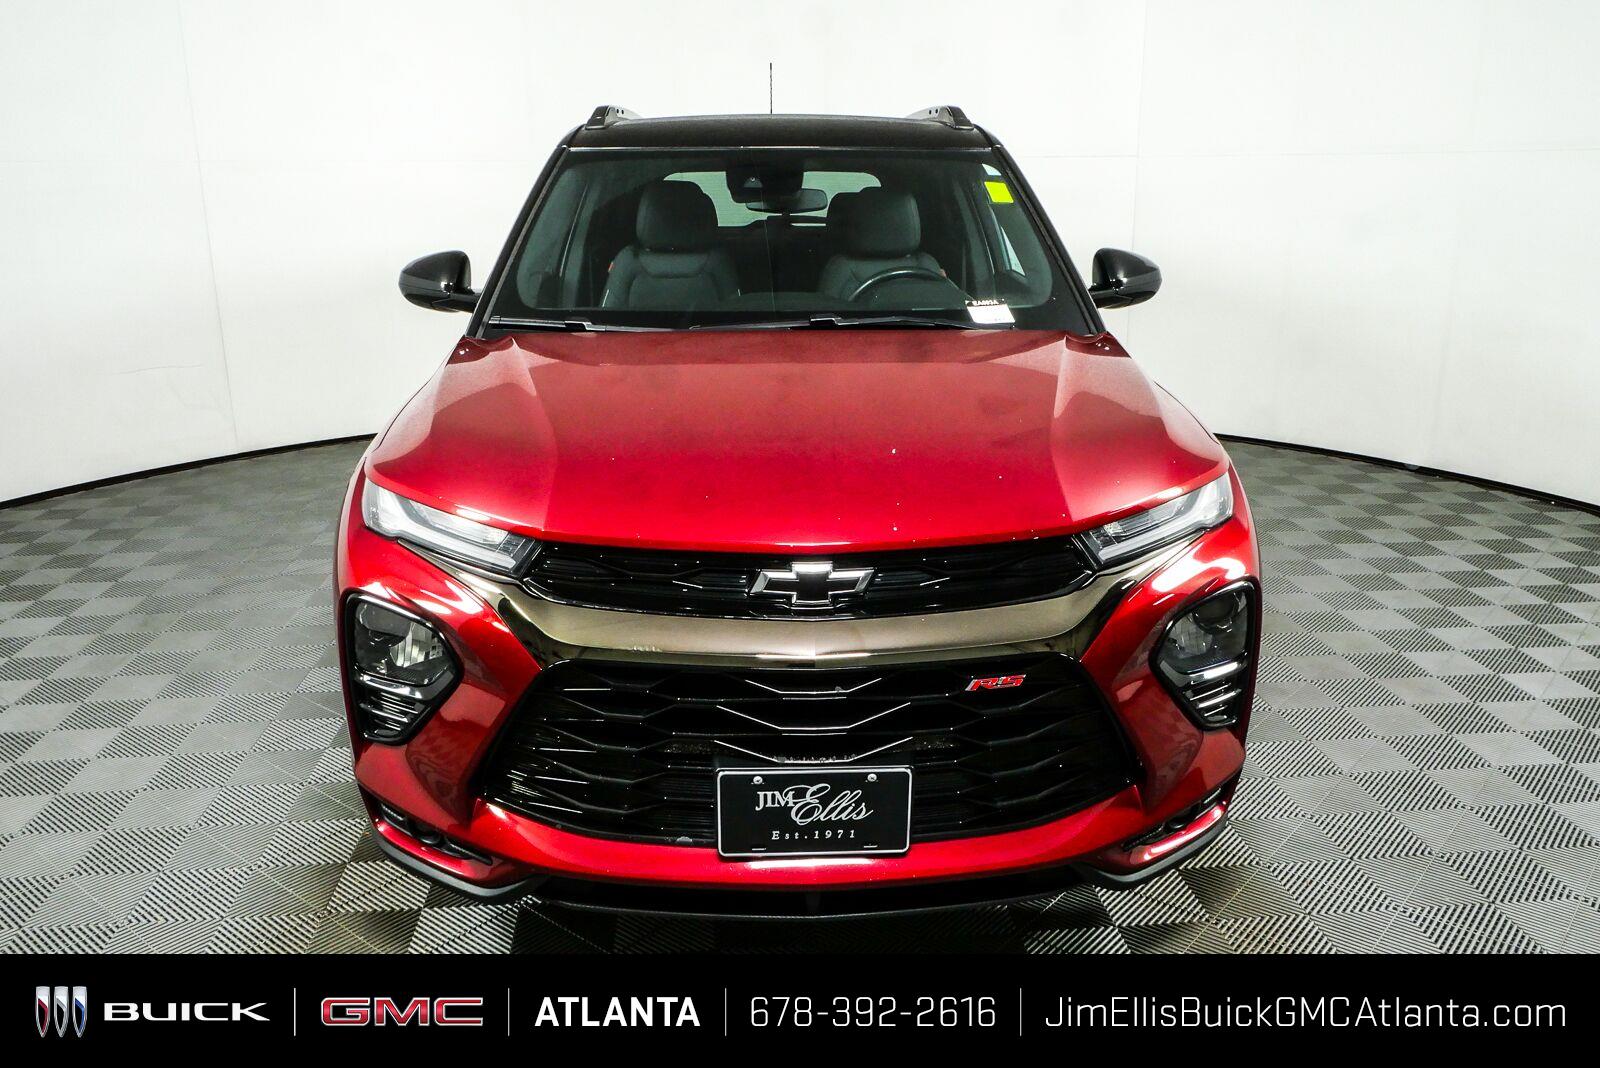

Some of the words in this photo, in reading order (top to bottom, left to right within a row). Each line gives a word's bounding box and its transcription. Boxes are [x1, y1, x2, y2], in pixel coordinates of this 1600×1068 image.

[965, 674, 1027, 691] RS
[755, 791, 795, 811] JIM
[782, 783, 874, 826] Ellis
